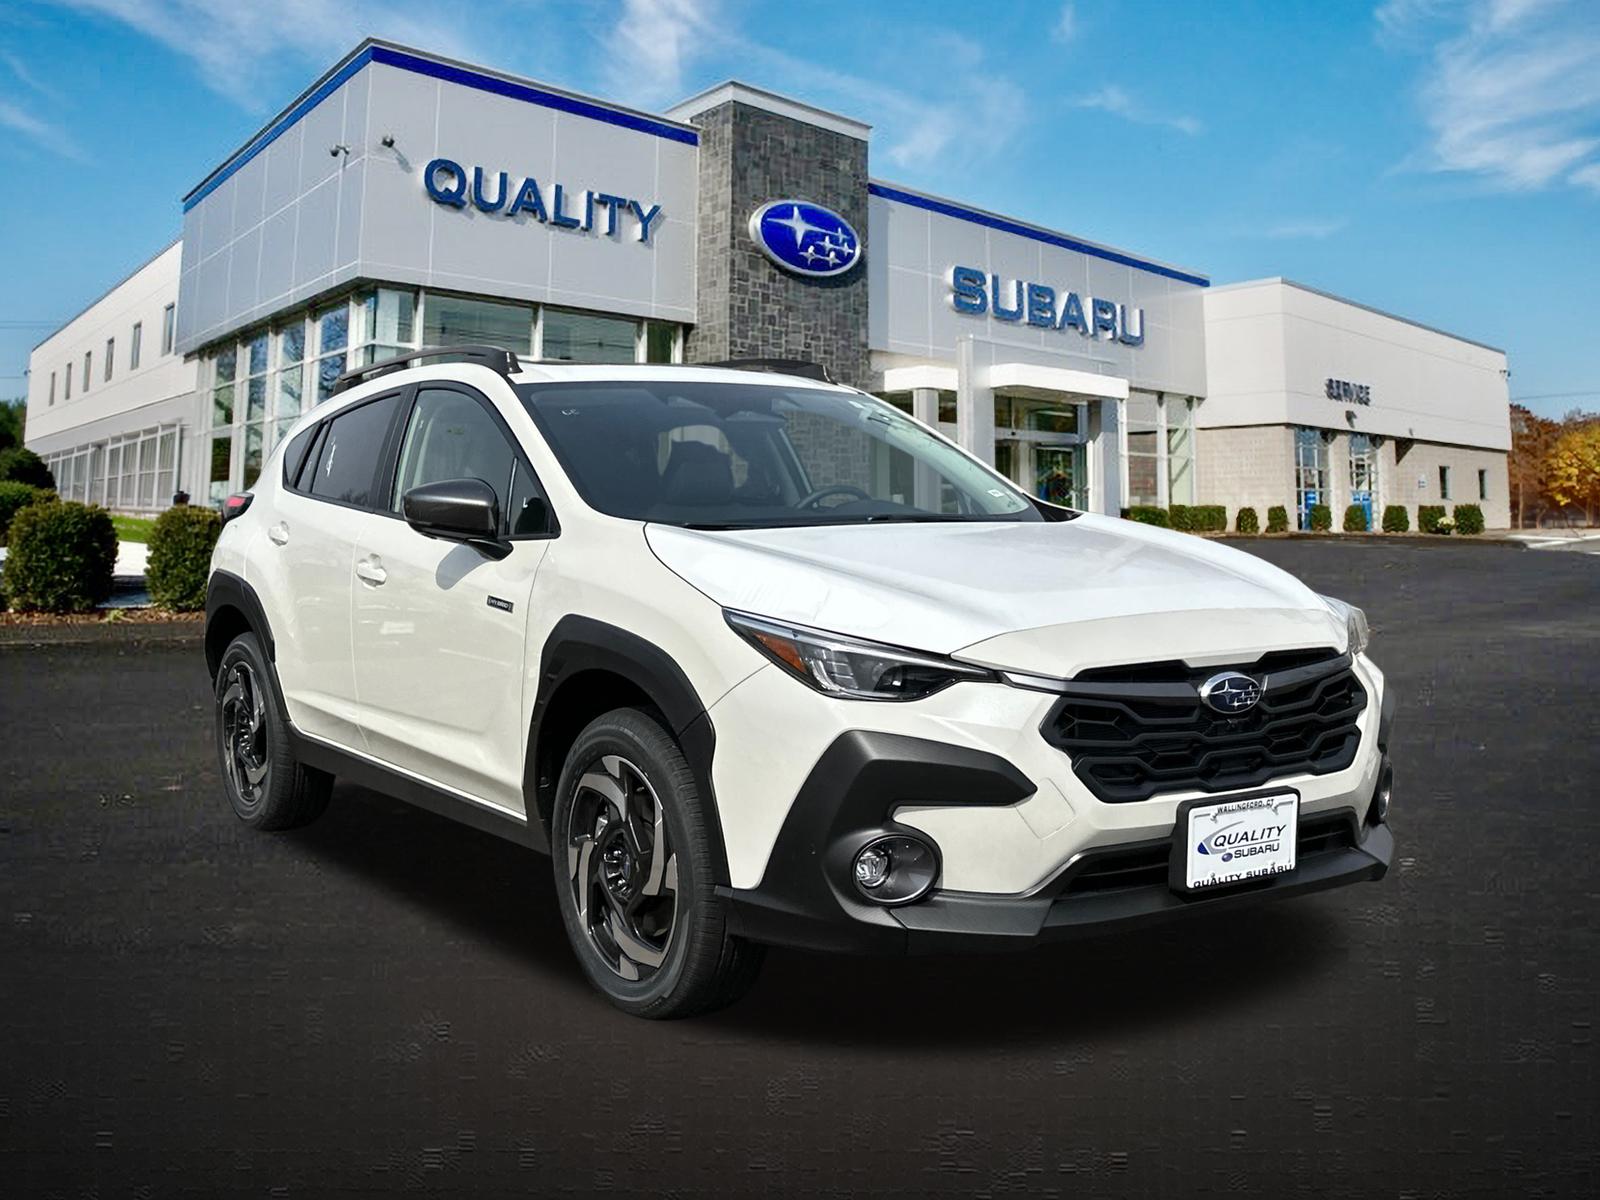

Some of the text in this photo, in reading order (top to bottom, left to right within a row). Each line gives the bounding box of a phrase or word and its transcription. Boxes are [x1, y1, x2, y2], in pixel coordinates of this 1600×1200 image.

[424, 158, 662, 243] QUALITY
[950, 265, 1145, 346] SUBARU
[1214, 824, 1287, 848] QUALITY
[1234, 842, 1280, 859] SUBARU
[1193, 863, 1293, 889] QUALITY SUBARU
